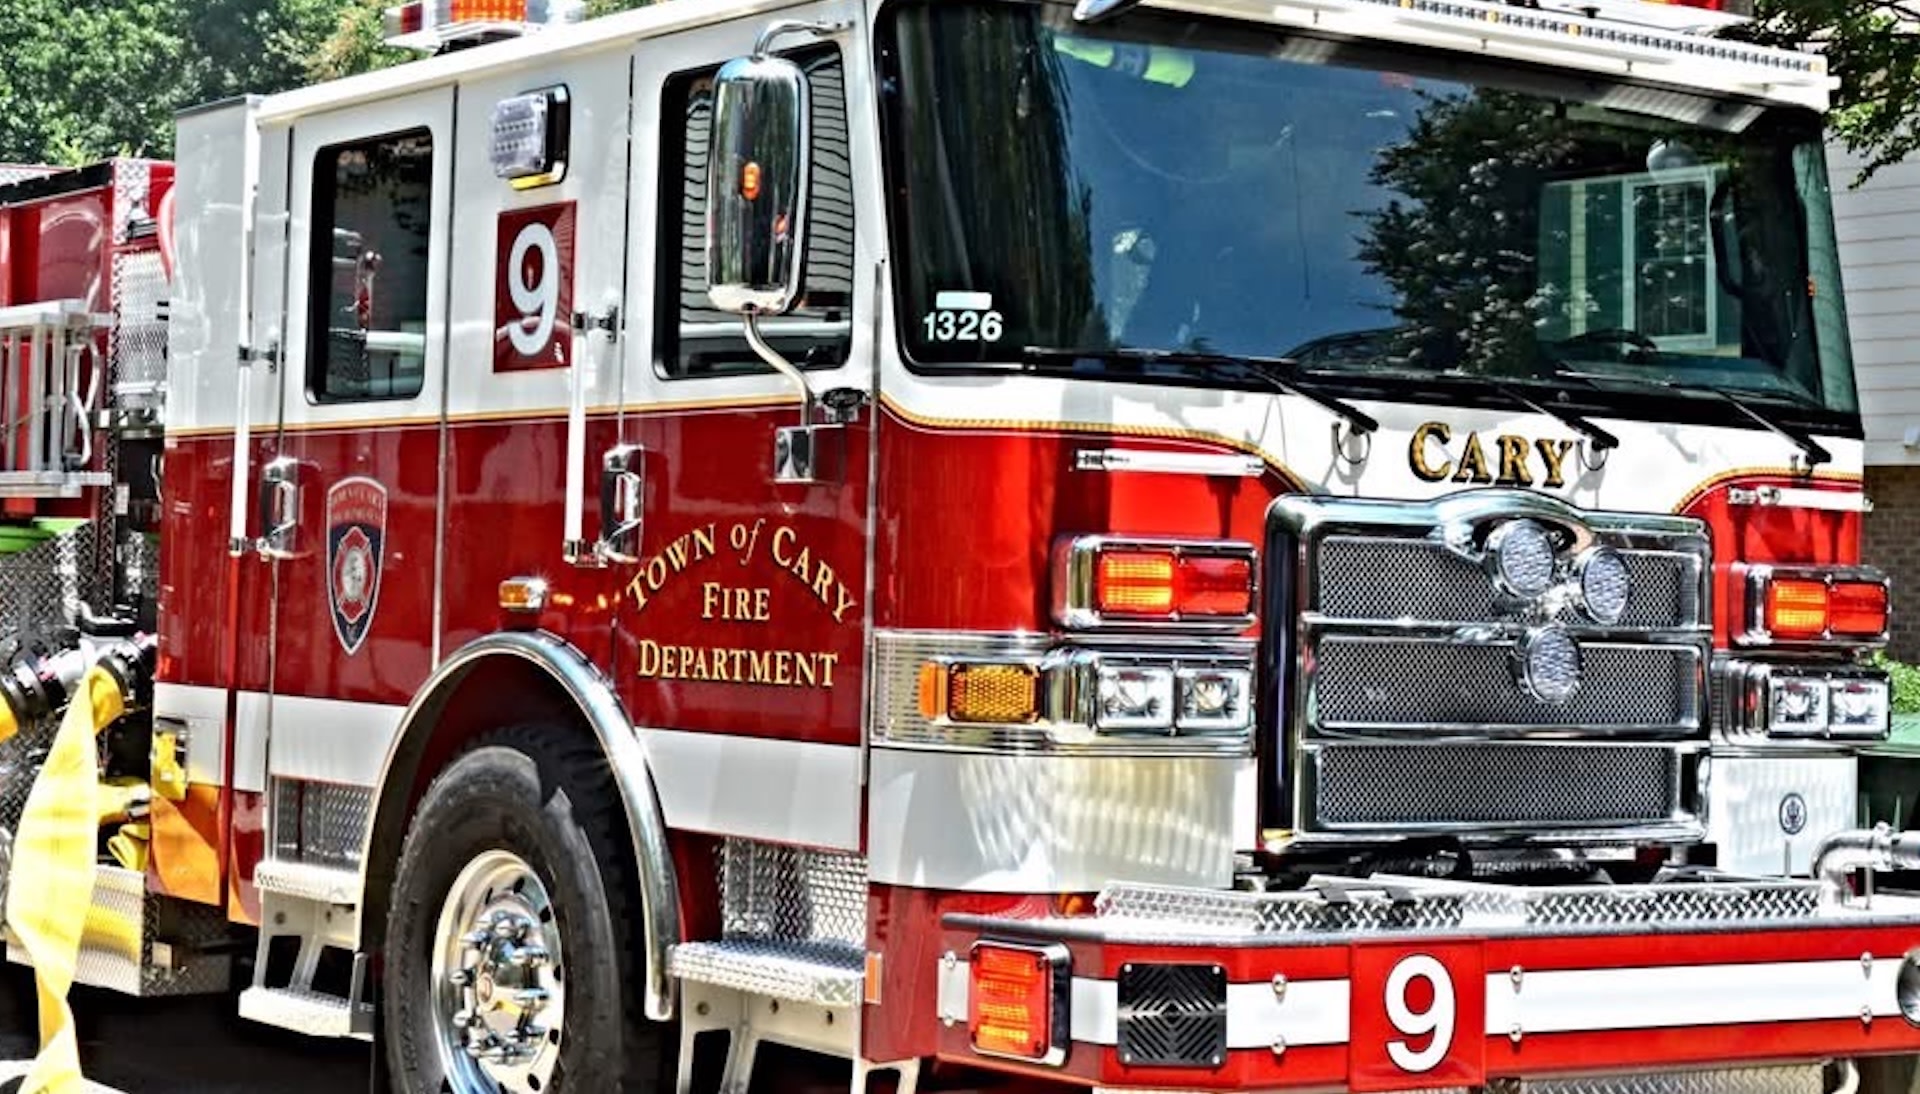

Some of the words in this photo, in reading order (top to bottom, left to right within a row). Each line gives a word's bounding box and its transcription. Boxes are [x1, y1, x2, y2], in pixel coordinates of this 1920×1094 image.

[508, 222, 560, 356] 9
[923, 309, 1004, 342] 1326
[1408, 421, 1574, 488] CARY
[626, 523, 716, 611] TOWN
[730, 518, 766, 566] of
[772, 526, 857, 624] CARY
[702, 581, 771, 621] FIRE
[637, 639, 839, 688] DEPARTMENT
[1384, 953, 1456, 1074] 9
